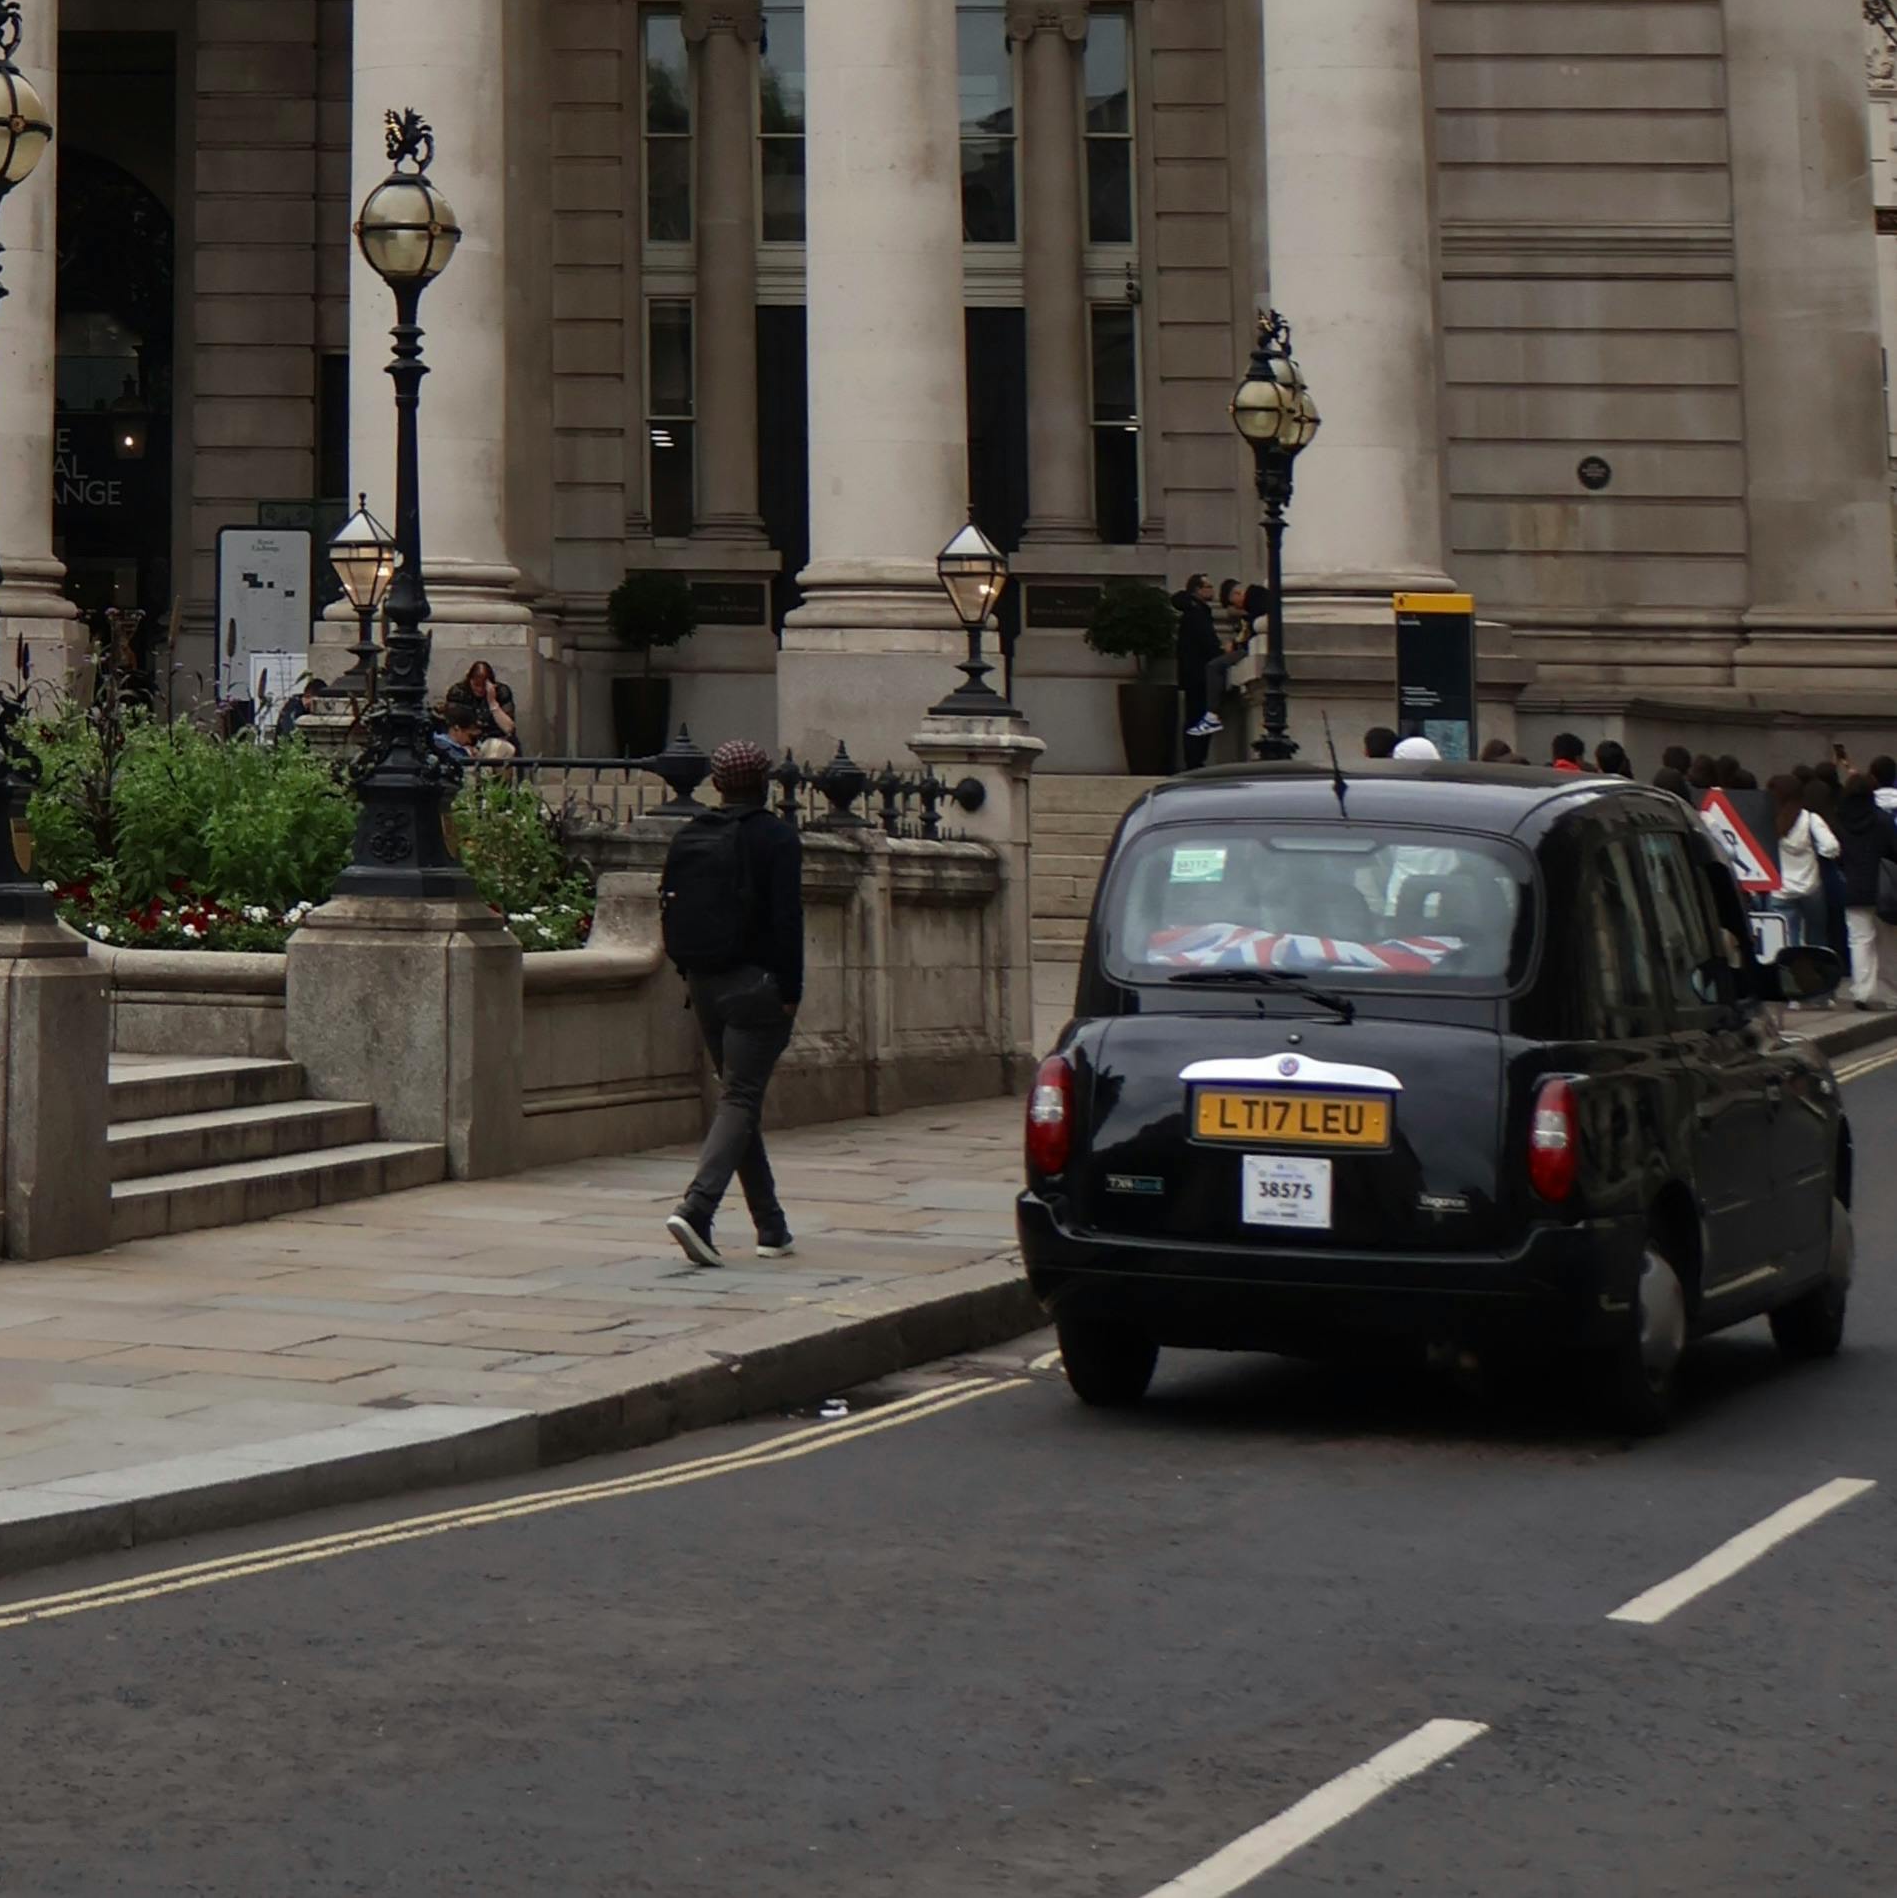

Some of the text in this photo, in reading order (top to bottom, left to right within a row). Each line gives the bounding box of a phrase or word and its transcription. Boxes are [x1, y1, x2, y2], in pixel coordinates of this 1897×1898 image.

[1219, 1099, 1364, 1135] LT17 LEU
[1258, 1181, 1313, 1200] 38575
